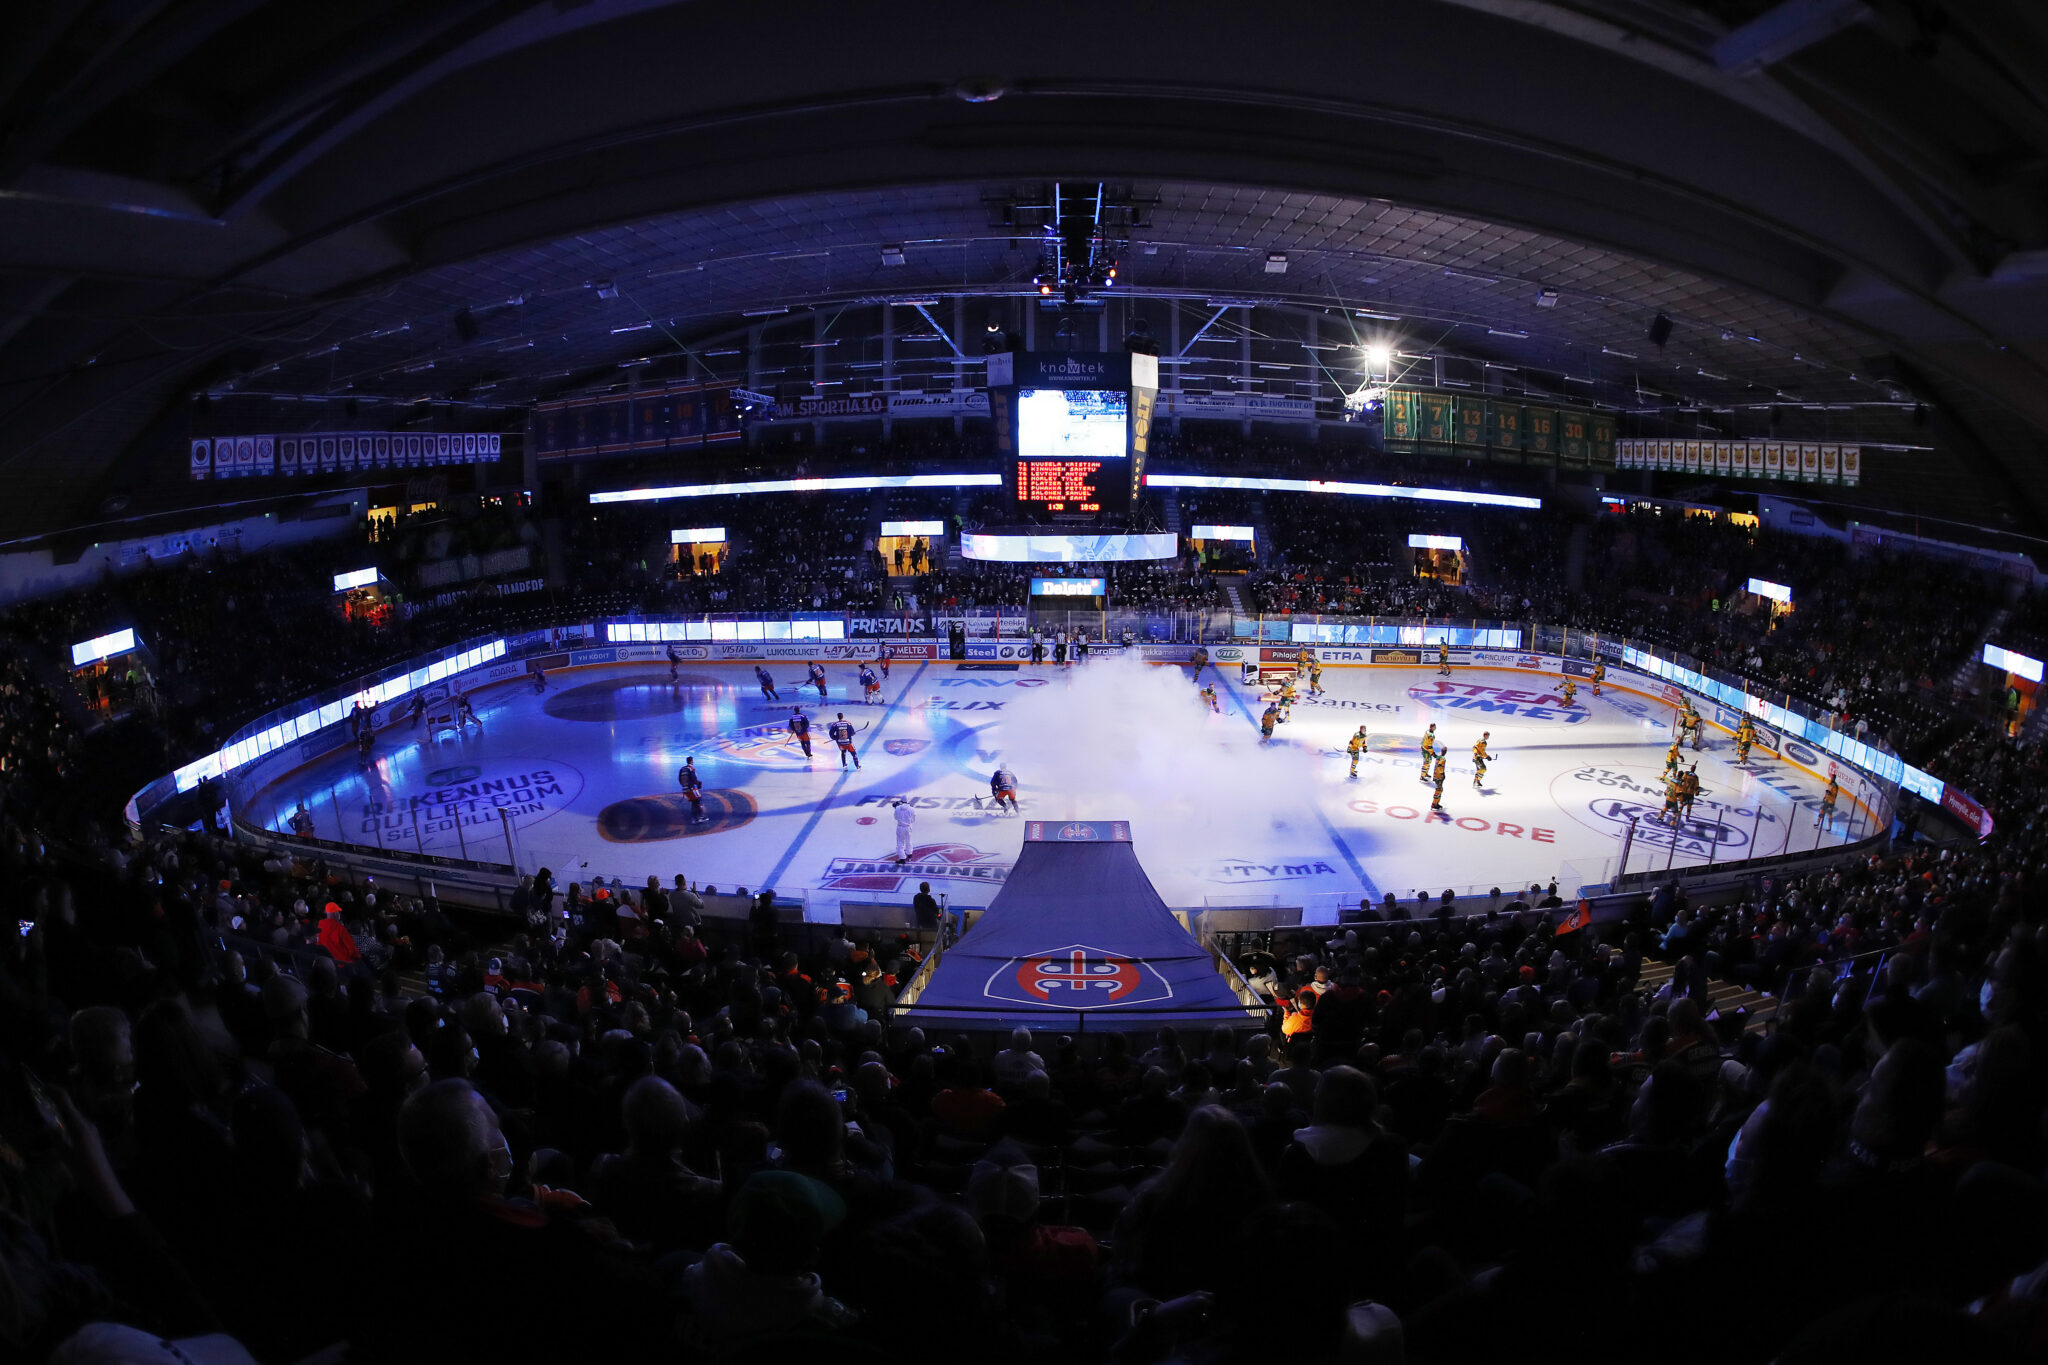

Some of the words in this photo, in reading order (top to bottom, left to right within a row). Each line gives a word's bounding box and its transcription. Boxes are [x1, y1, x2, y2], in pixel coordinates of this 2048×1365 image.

[1040, 359, 1105, 374] knowtek
[1395, 403, 1407, 419] 2
[1431, 406, 1442, 421] 7
[1463, 409, 1481, 425] 13
[1499, 413, 1517, 431] 14
[1533, 418, 1551, 434] 16
[1565, 423, 1583, 439] 30
[850, 617, 925, 634] FRISTADS
[722, 645, 745, 654] VISTA
[766, 648, 819, 656] LUKKOLUKET
[824, 645, 876, 654] LATVALA
[896, 646, 928, 655] MELTEX
[967, 648, 996, 657] Steel
[1322, 651, 1363, 661] ETRA
[1485, 653, 1514, 662] FINCUMET
[1303, 695, 1406, 712] Sanser
[1580, 767, 1634, 783] JTA
[387, 827, 416, 842] SE
[1631, 826, 1706, 853] PIZZA
